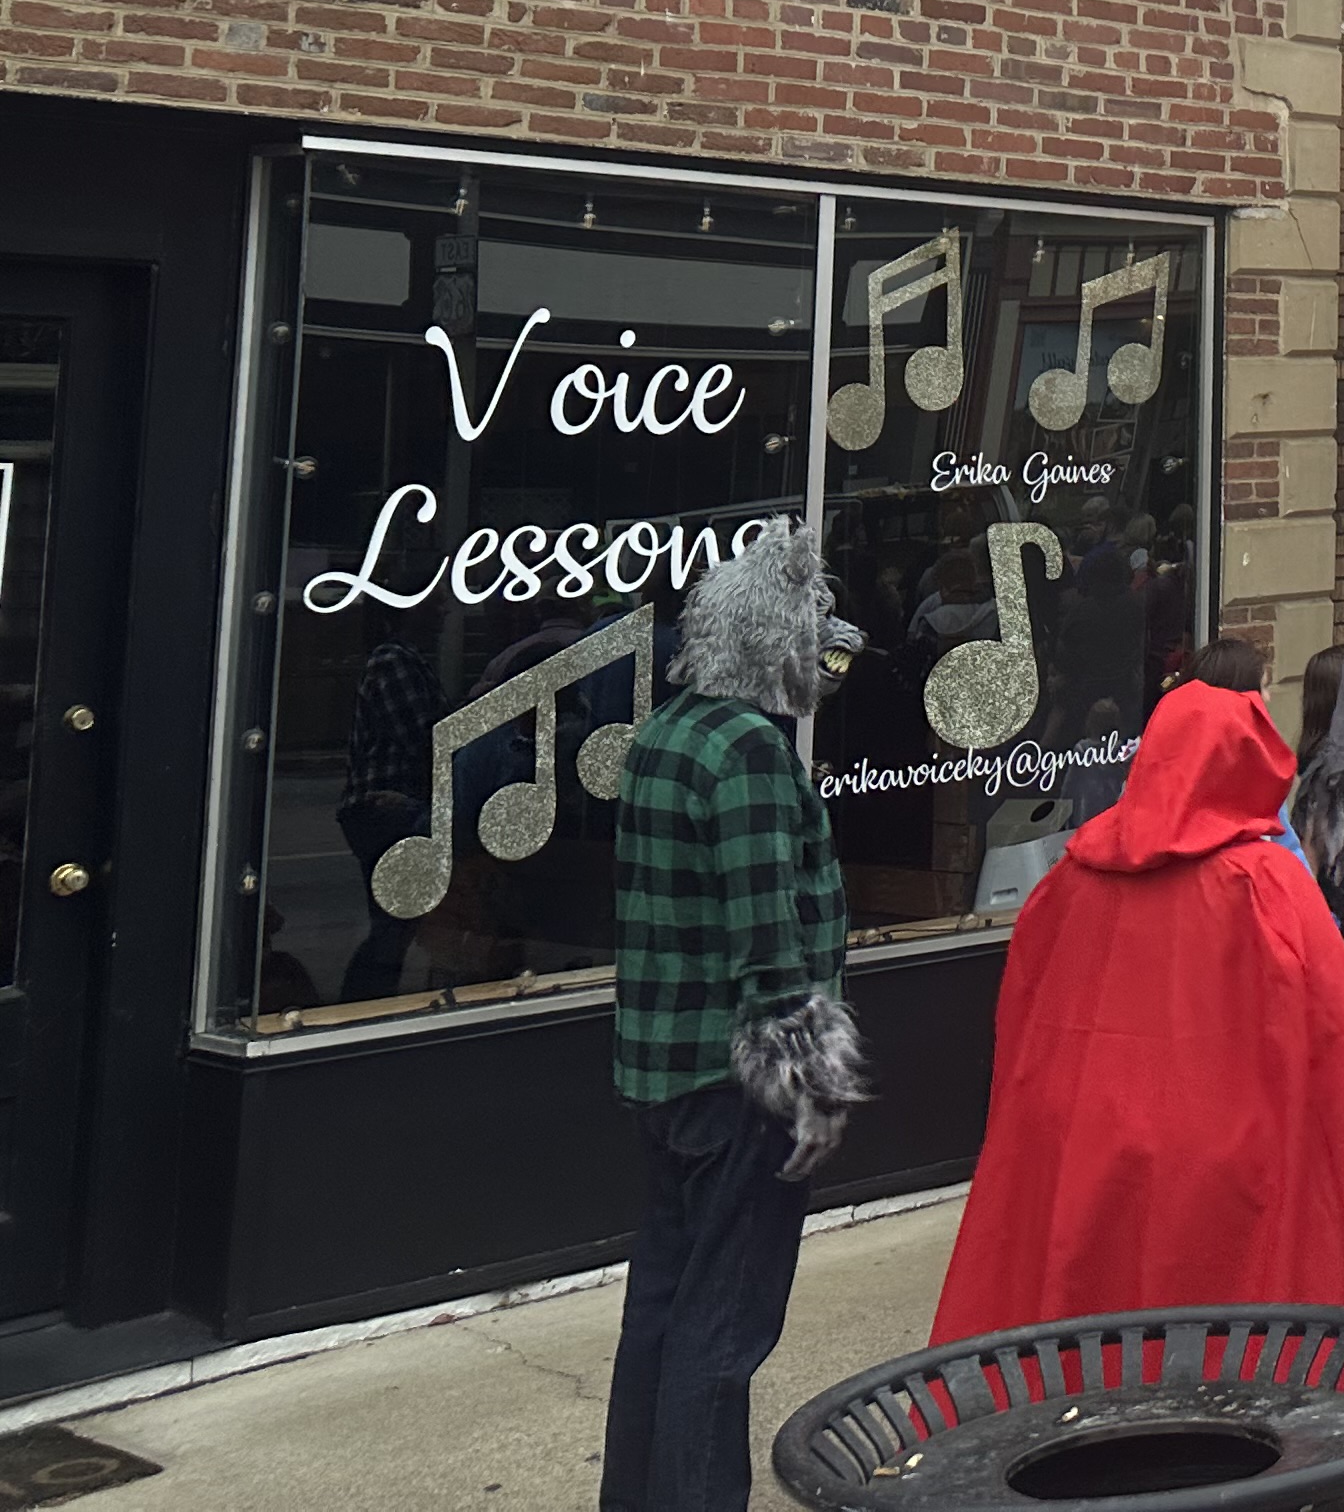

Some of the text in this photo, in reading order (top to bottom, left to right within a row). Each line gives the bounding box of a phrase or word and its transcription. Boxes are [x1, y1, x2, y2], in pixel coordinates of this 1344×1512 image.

[424, 307, 746, 442] Voice
[930, 451, 1116, 504] Erika Gaines
[820, 730, 1119, 799] erikavoiceky@gmail
